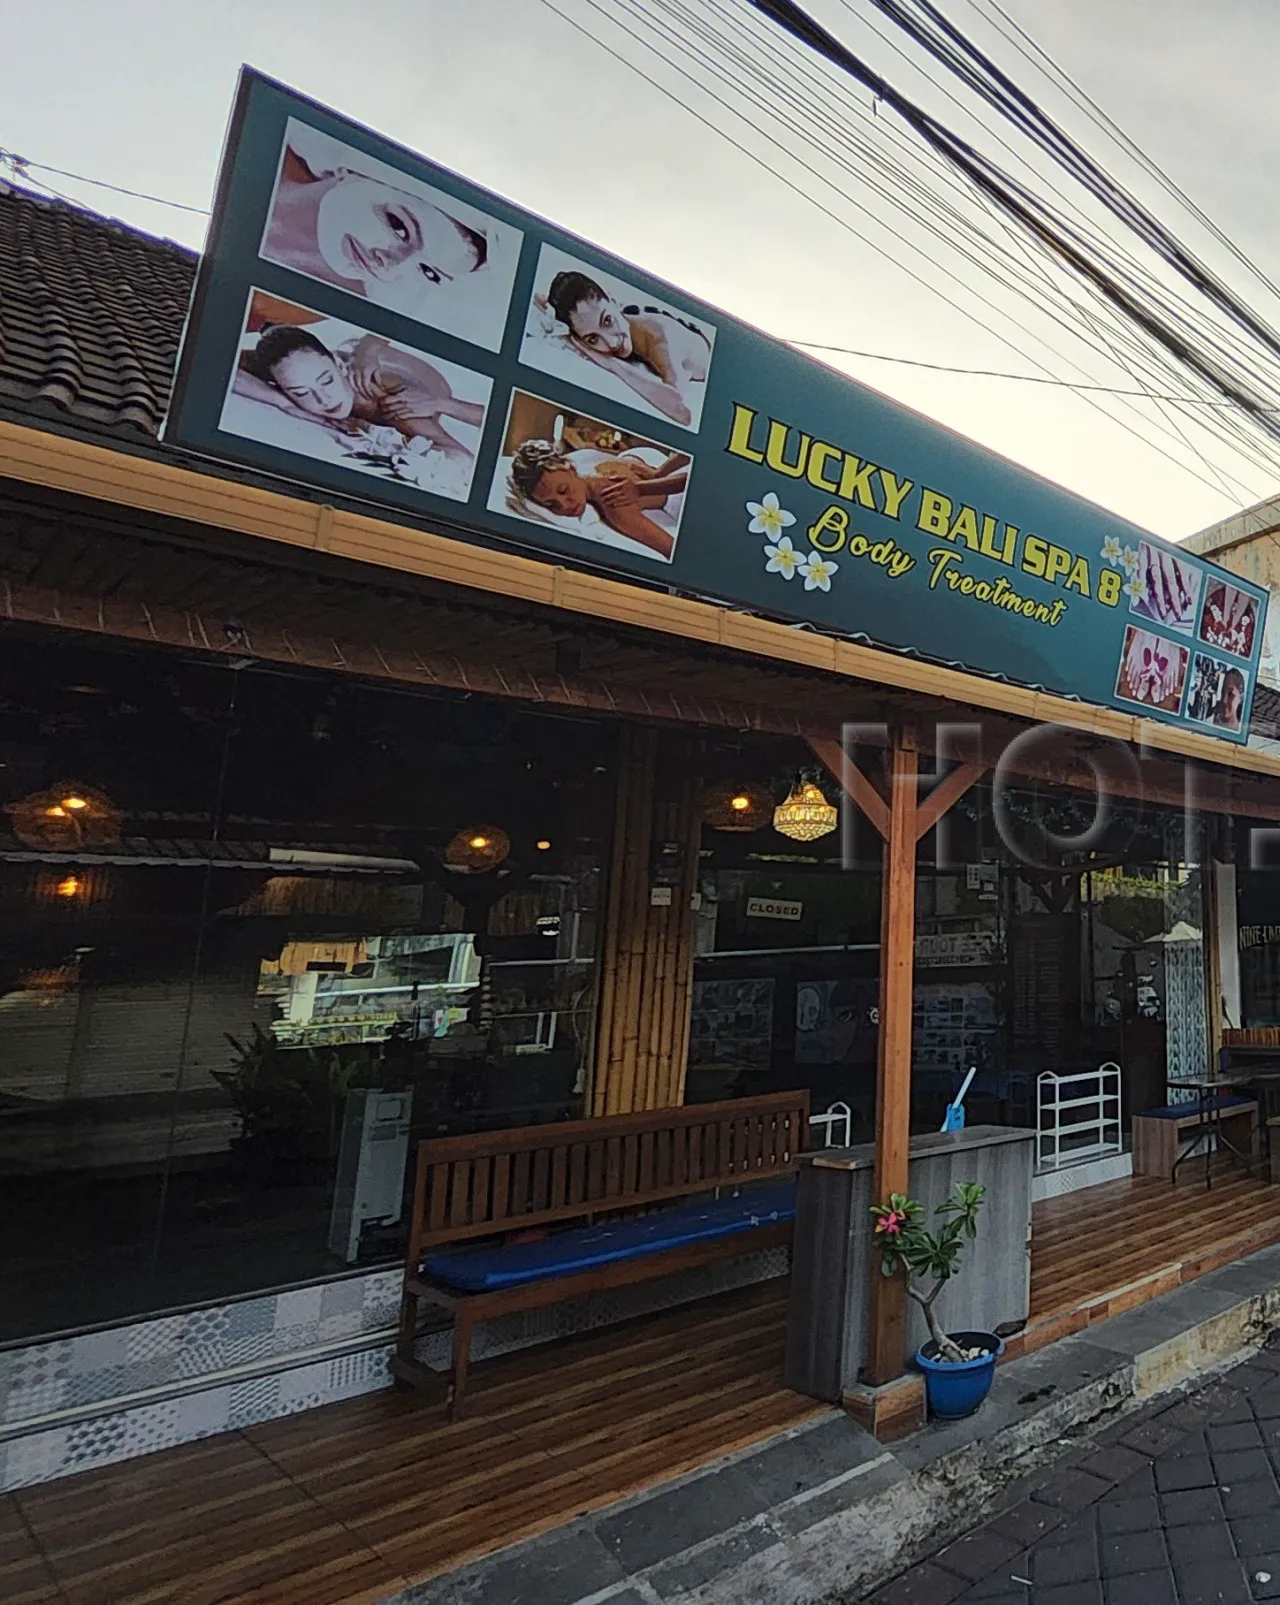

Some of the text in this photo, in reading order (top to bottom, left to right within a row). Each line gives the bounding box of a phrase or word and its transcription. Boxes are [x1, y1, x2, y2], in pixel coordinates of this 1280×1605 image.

[725, 401, 1122, 607] LUCKY BALI SPA 8
[806, 504, 1067, 628] Body Treatment
[750, 903, 799, 916] CLOSED
